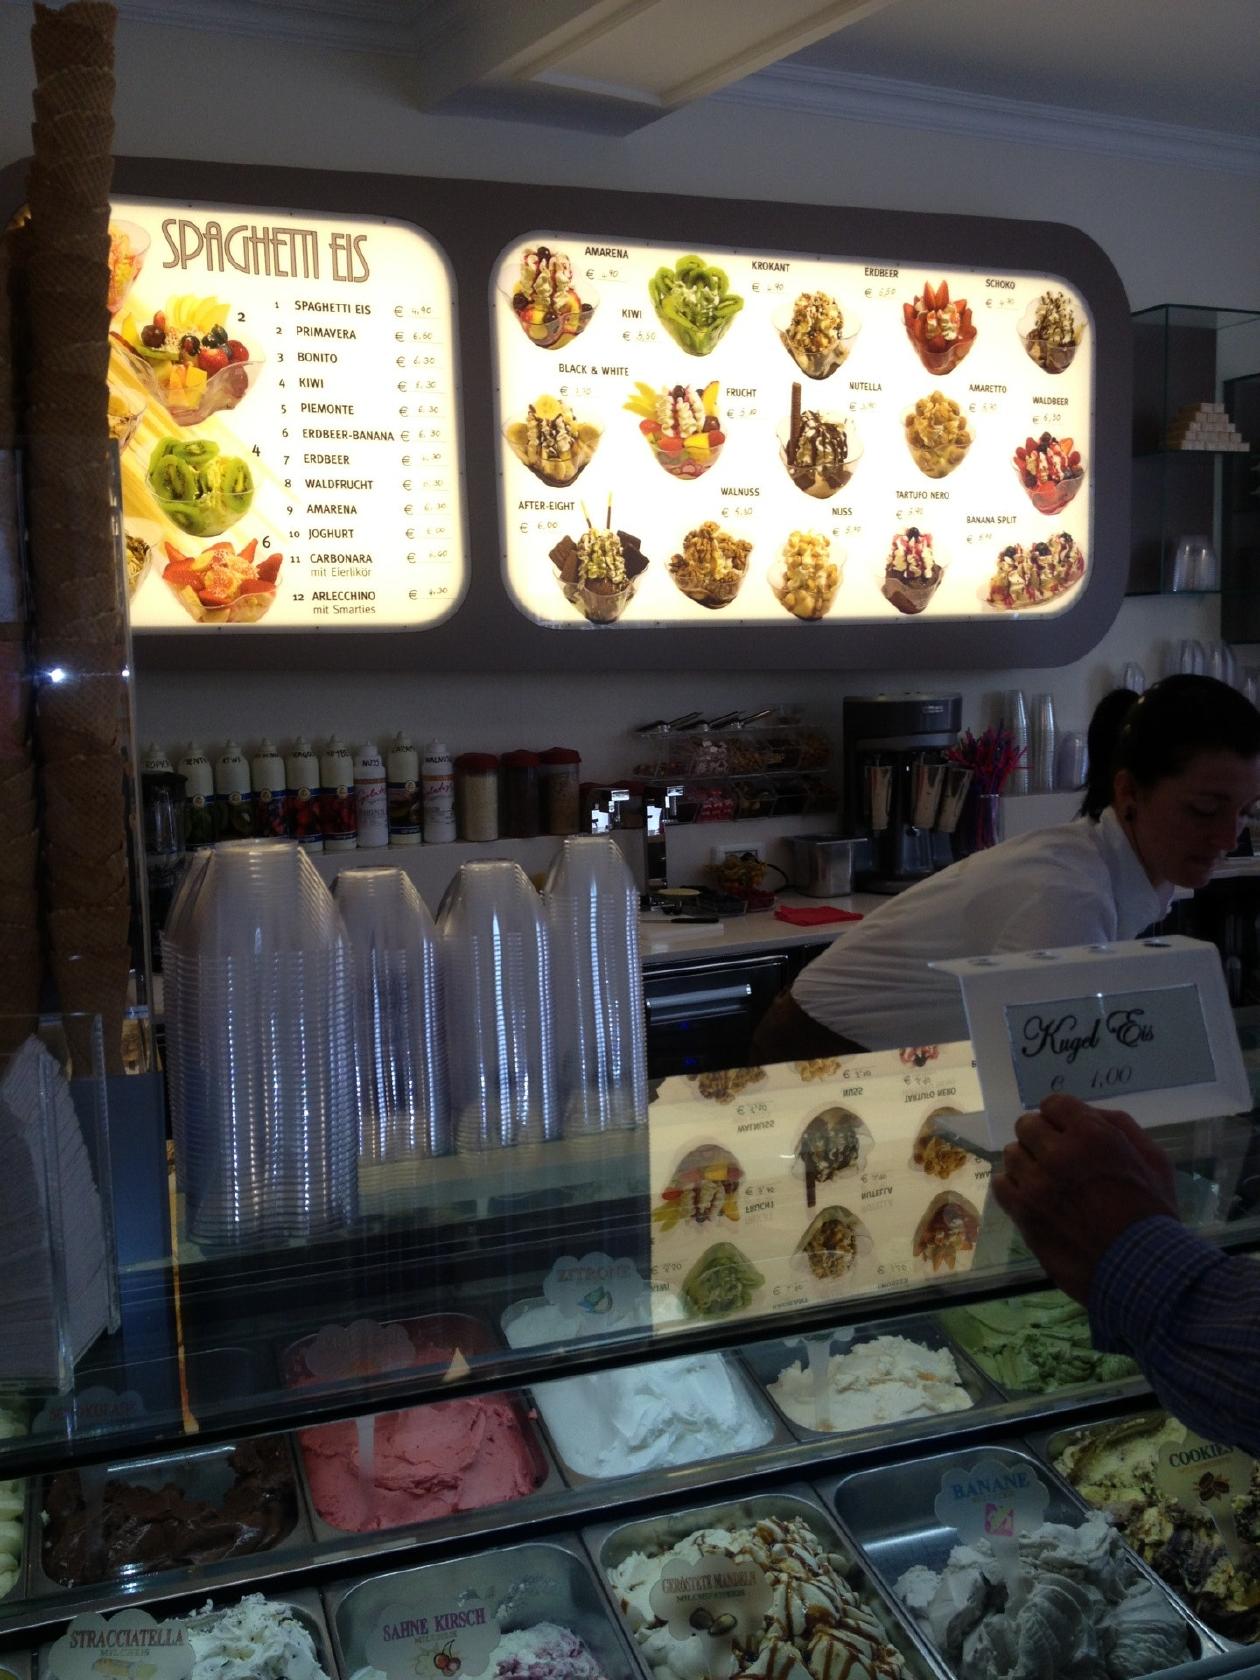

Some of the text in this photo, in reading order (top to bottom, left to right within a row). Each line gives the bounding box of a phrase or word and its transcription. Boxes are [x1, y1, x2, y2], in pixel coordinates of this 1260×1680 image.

[161, 218, 370, 283] SPAGHETTI EIS
[585, 246, 629, 259] AMARENA
[752, 261, 790, 272] KROKANT
[586, 269, 594, 280] €
[864, 267, 898, 278] ERDBEER
[752, 283, 759, 292] €
[986, 279, 1015, 289] SCHOKO
[865, 288, 872, 298] €
[295, 300, 350, 313] SPAGHETTI
[355, 305, 371, 315] EIS
[394, 306, 403, 317] €
[986, 299, 992, 308] €
[238, 312, 245, 322] 2
[622, 309, 641, 318] KIWI
[297, 326, 356, 339] PRIMAVERA
[395, 332, 404, 342] €
[622, 331, 630, 341] €
[278, 353, 283, 362] 3
[298, 352, 337, 363] BONITO
[396, 356, 405, 367] €
[559, 363, 587, 374] BLACK
[602, 367, 628, 376] WHITE
[279, 379, 285, 388] 4
[299, 378, 323, 388] KIWI
[397, 381, 406, 392] €
[850, 382, 881, 391] NUTELLA
[969, 384, 1007, 393] AMARETTO
[560, 386, 568, 396] €
[727, 388, 756, 397] FRUCHT
[1033, 397, 1068, 405] WALDBEER
[281, 405, 286, 414] 5
[301, 403, 354, 415] PIEMONTE
[399, 407, 408, 417] €
[282, 428, 288, 437] 6
[303, 429, 394, 440] ERDBEER-BANANA
[400, 431, 409, 442] €
[252, 445, 260, 457] 4
[284, 456, 289, 465] 7
[304, 454, 349, 464] ERDBEER
[402, 456, 410, 466] €
[284, 479, 291, 488] 8
[305, 479, 373, 489] WALDFRUCHT
[402, 480, 411, 491] €
[721, 488, 759, 496] WALNUSS
[896, 491, 928, 499] TARTUFO
[287, 506, 293, 515] 9
[307, 504, 357, 514] AMARENA
[404, 505, 412, 515] €
[518, 501, 574, 510] AFTER-EIGHT
[998, 516, 1016, 524] SPLIT
[519, 523, 528, 533] €
[309, 529, 353, 540] JOGHURT
[405, 528, 414, 539] €
[262, 536, 270, 548] 6
[310, 554, 372, 563] CARBONARA
[406, 553, 416, 563] €
[311, 567, 370, 577] mit Eierlikör
[312, 592, 375, 601] ARLECCHINO
[409, 590, 417, 600] €
[313, 605, 375, 614] mit Smarties
[1022, 1009, 1154, 1063] Kugel Eis
[952, 1472, 1030, 1498] BANANE
[383, 1607, 486, 1641] SAHNE KIRSCH
[70, 1629, 185, 1648] STRACCIATELLA
